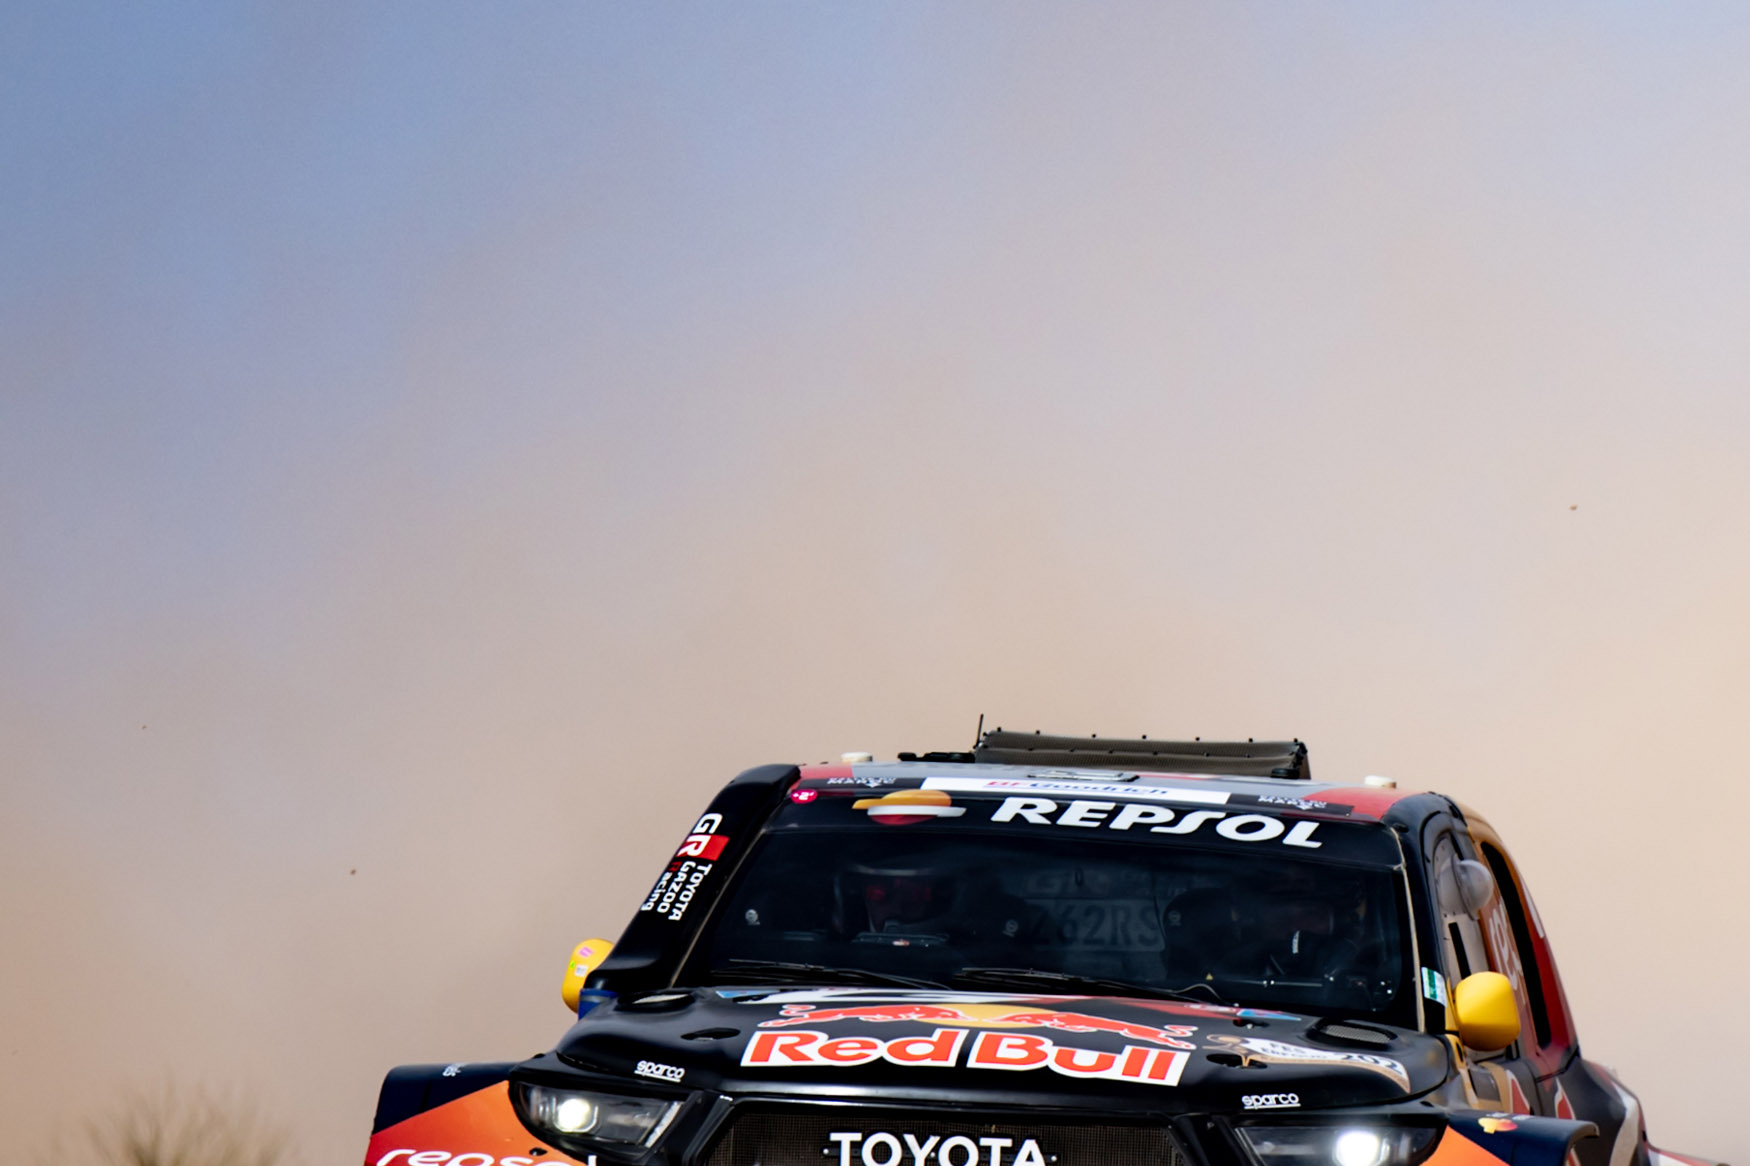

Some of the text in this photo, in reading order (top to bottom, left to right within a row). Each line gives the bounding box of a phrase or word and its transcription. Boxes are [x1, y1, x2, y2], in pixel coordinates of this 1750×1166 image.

[676, 813, 723, 857] GR
[990, 797, 1323, 849] REPSOL
[656, 861, 696, 913] GAZOO
[668, 864, 713, 920] TOYOTA
[635, 1060, 686, 1081] sparco
[746, 1030, 1182, 1083] Red Bull
[1242, 1093, 1300, 1108] sparco
